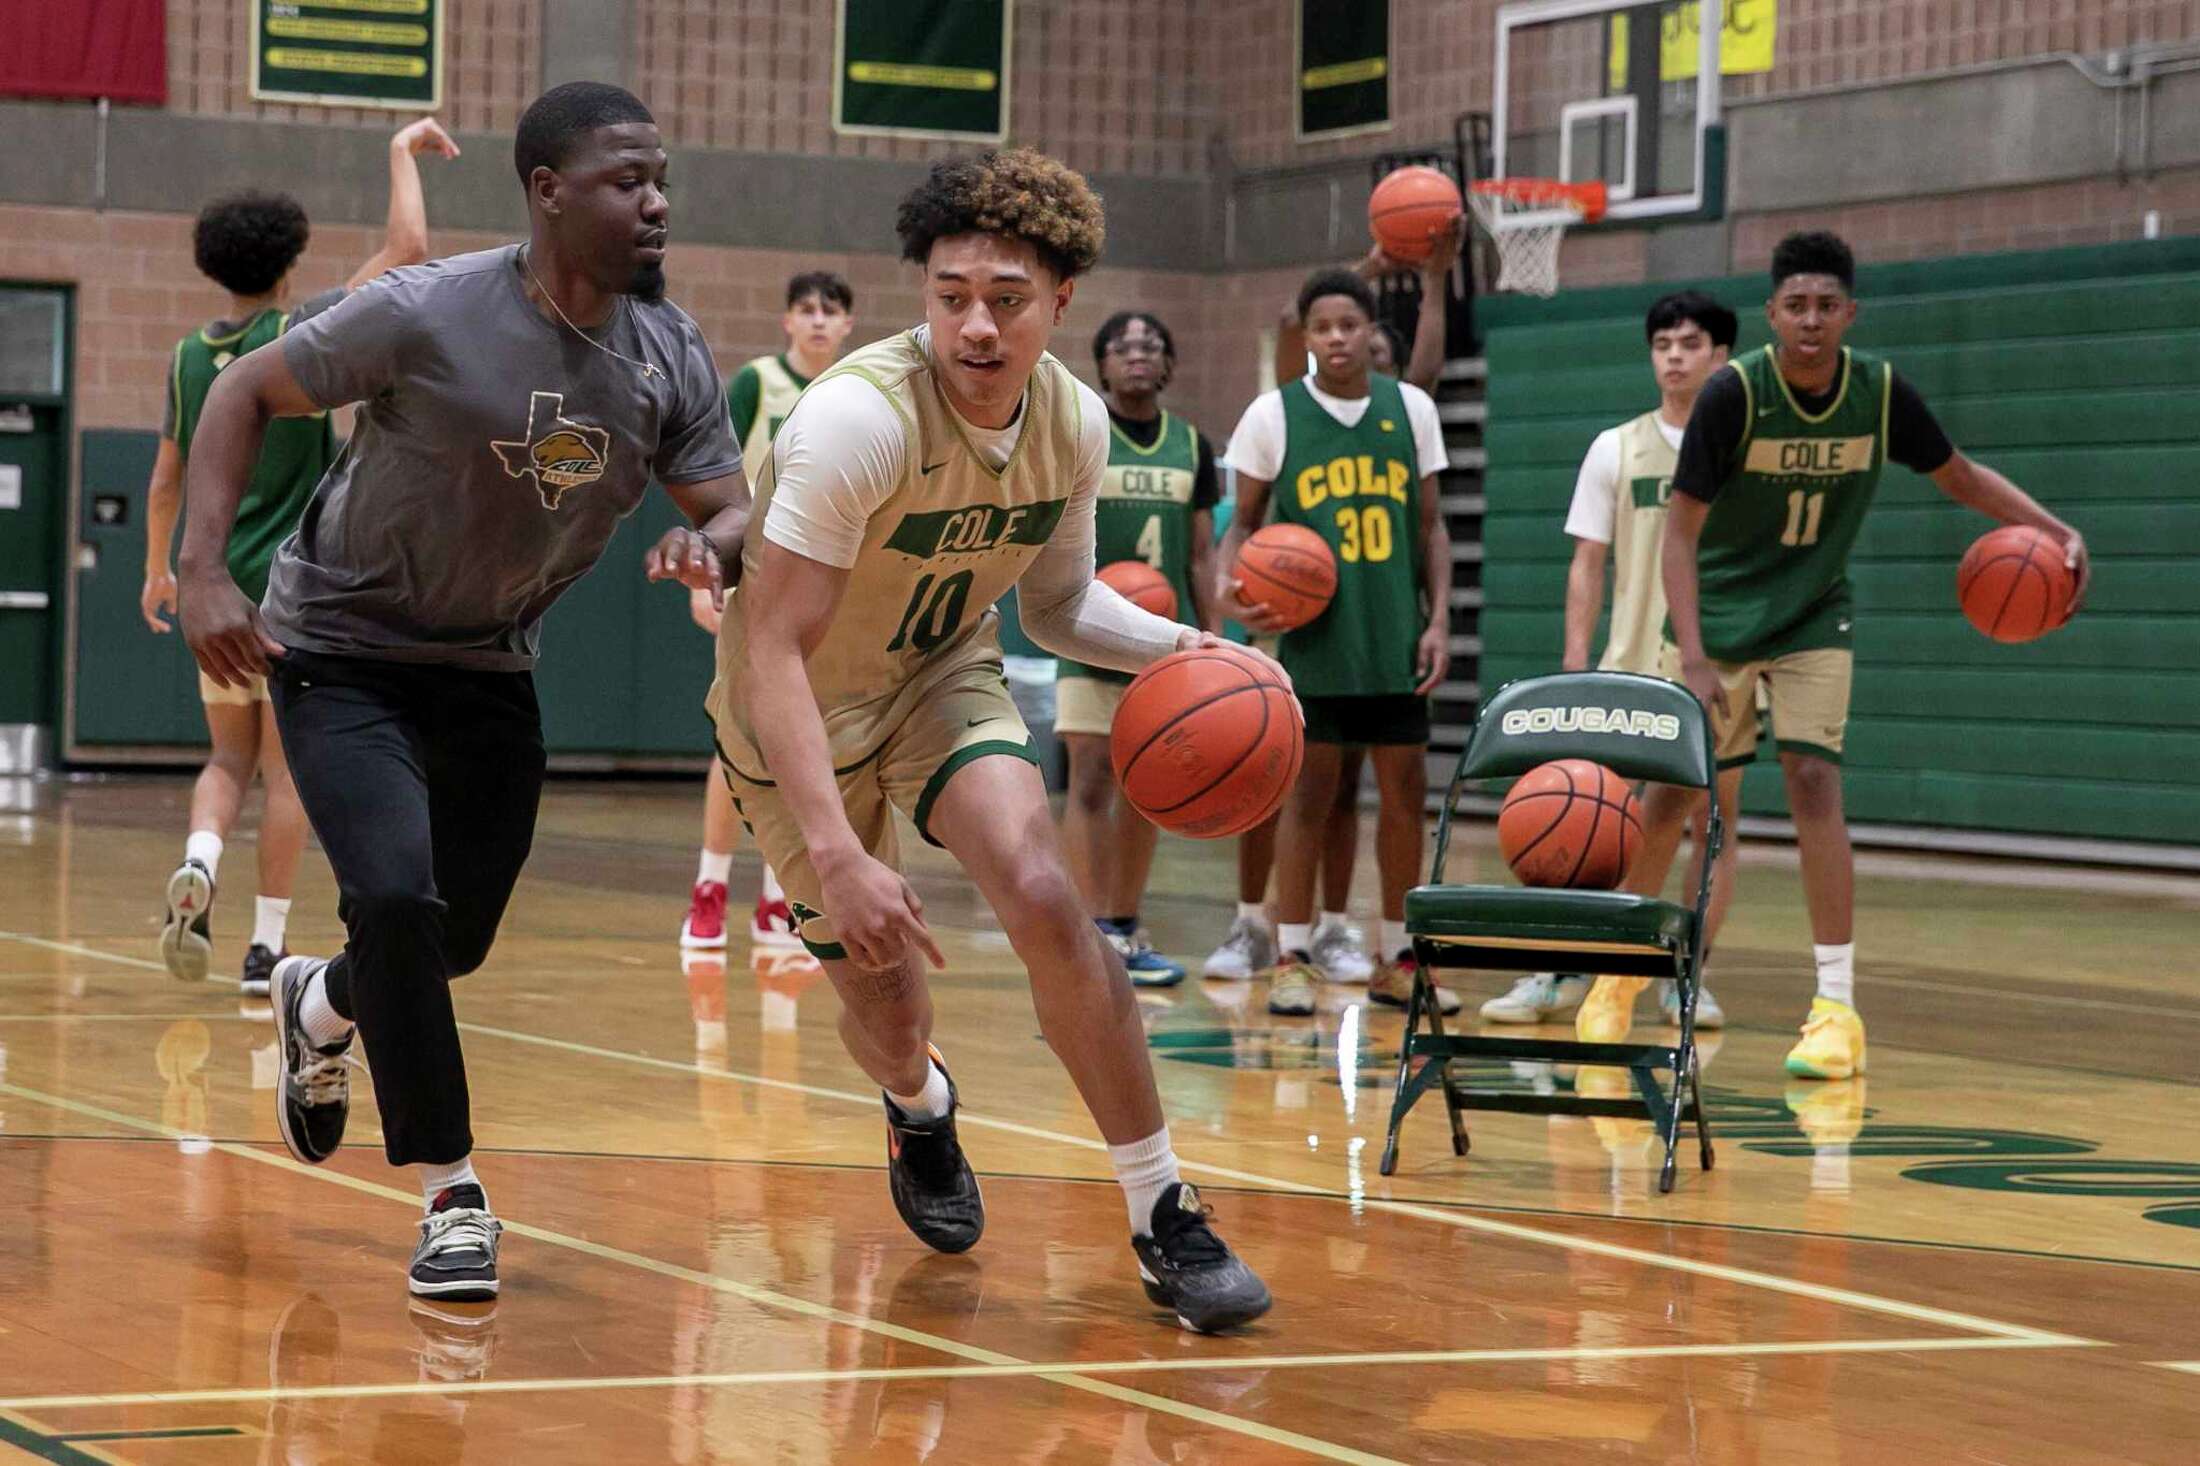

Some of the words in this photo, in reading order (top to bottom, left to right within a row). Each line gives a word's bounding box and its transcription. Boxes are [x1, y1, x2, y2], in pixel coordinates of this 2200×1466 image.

[1122, 469, 1174, 496] COLE
[1296, 455, 1410, 510] COLE
[1780, 442, 1846, 471] COLE
[935, 509, 1028, 552] COLE
[1136, 514, 1163, 569] 4
[1334, 505, 1393, 563] 30
[1780, 490, 1825, 546] 11
[886, 569, 975, 654] 10
[1502, 707, 1680, 740] COUGARS
